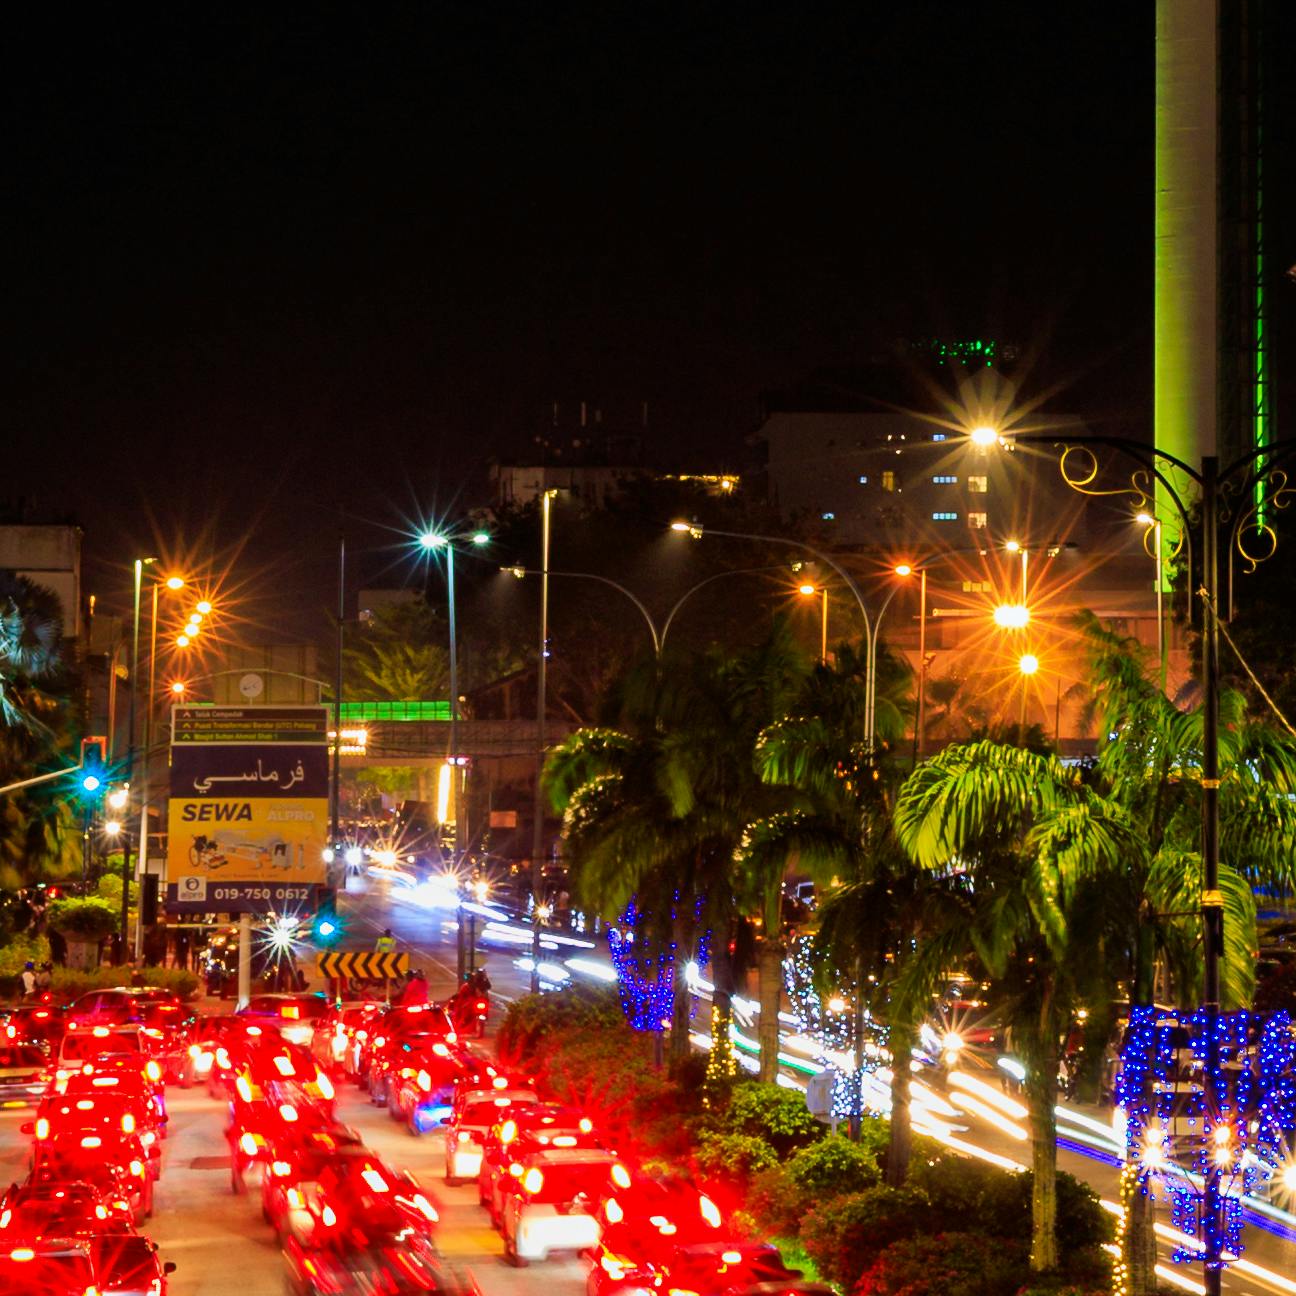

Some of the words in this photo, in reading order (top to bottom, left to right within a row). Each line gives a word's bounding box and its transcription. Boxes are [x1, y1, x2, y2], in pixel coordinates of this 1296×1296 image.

[182, 803, 252, 821] SEWA
[268, 810, 315, 821] ALPRO
[214, 889, 271, 900] 019-750
[275, 889, 309, 900] 0612
